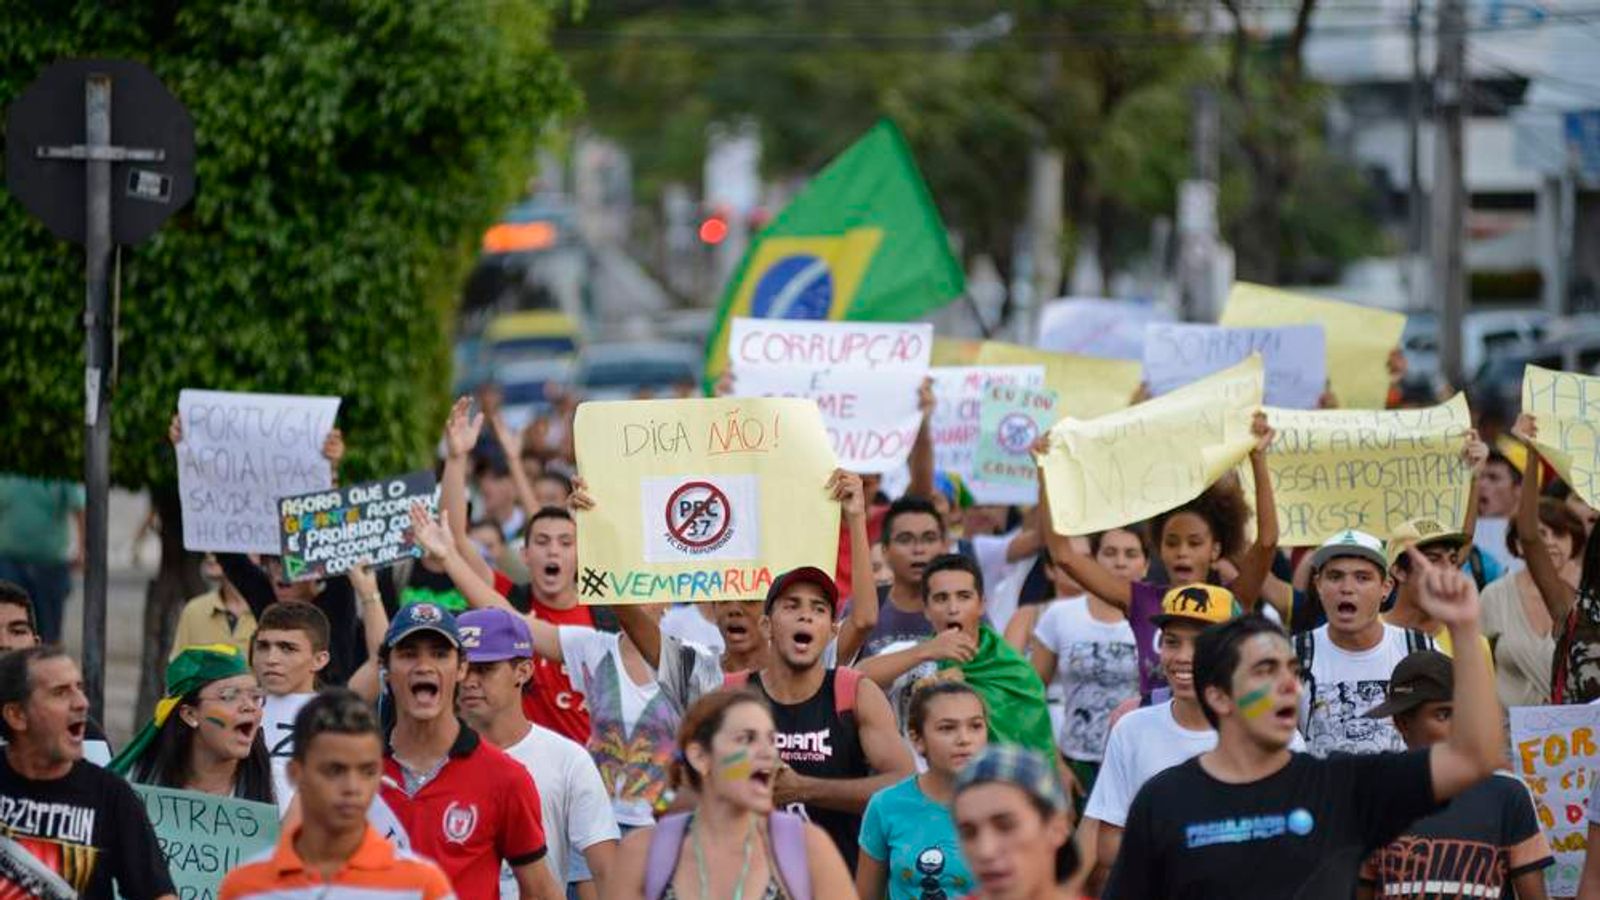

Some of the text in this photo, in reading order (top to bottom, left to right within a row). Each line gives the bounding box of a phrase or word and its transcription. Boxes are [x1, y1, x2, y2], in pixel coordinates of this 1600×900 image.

[740, 330, 922, 369] CORRUPÇÃO
[623, 420, 692, 456] DIGA
[282, 480, 406, 515] AGORA QUE O
[680, 500, 718, 518] PEC
[581, 567, 773, 598] #VEMPRARUA
